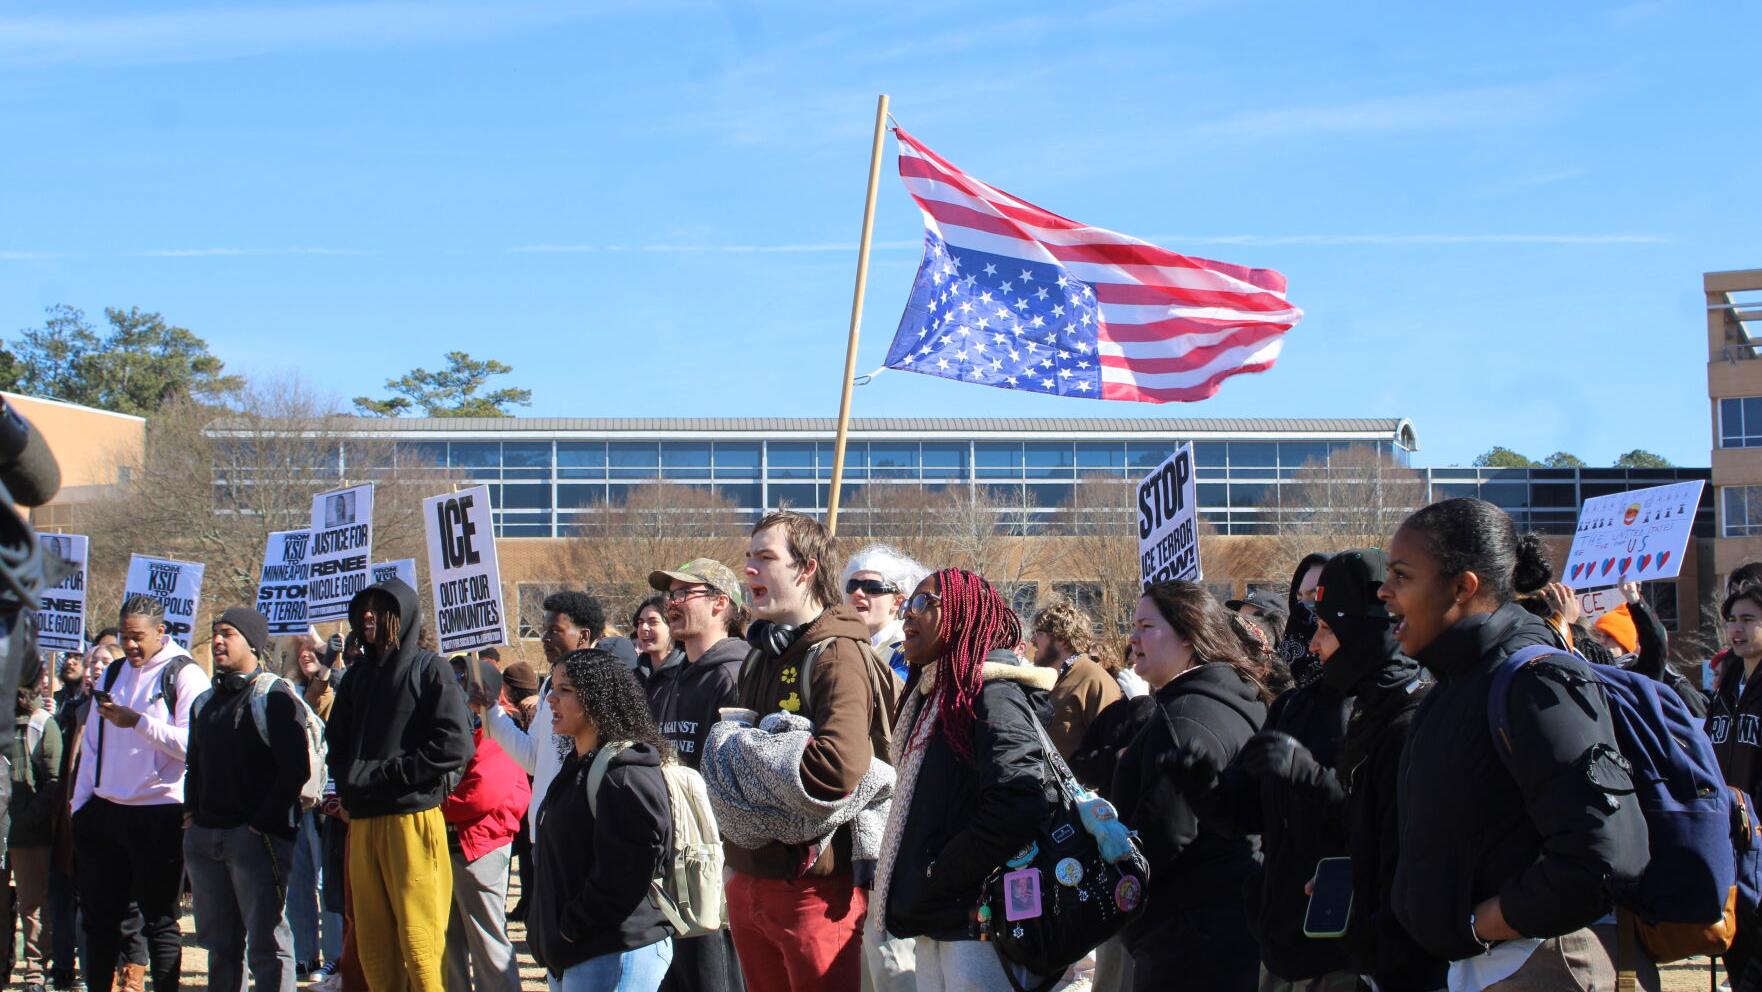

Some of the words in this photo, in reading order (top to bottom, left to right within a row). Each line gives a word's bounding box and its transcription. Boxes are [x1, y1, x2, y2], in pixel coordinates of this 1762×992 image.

[1138, 450, 1190, 540] STOP
[285, 533, 310, 542] FROM
[311, 527, 349, 557] JUSTICE
[349, 523, 369, 550] FOR
[436, 494, 481, 570] ICE
[283, 540, 308, 561] KSU
[1141, 547, 1158, 579] ICE
[1156, 517, 1194, 566] TERROR
[148, 562, 182, 573] FROM
[262, 563, 309, 582] MINNEAPOL
[310, 555, 367, 578] RENEE
[148, 569, 178, 593] KSU
[309, 576, 340, 601] NICOLE
[341, 573, 366, 597] GOOD
[440, 580, 458, 608] OUT
[458, 577, 469, 604] OF
[469, 573, 490, 602] OUR
[155, 589, 168, 597] TO
[1581, 592, 1605, 614] CE
[40, 597, 82, 613] ENEE
[273, 600, 308, 621] TERRO
[55, 614, 81, 636] GOOD
[438, 599, 500, 635] COMMUNITIES
[1710, 711, 1762, 748] ROWN
